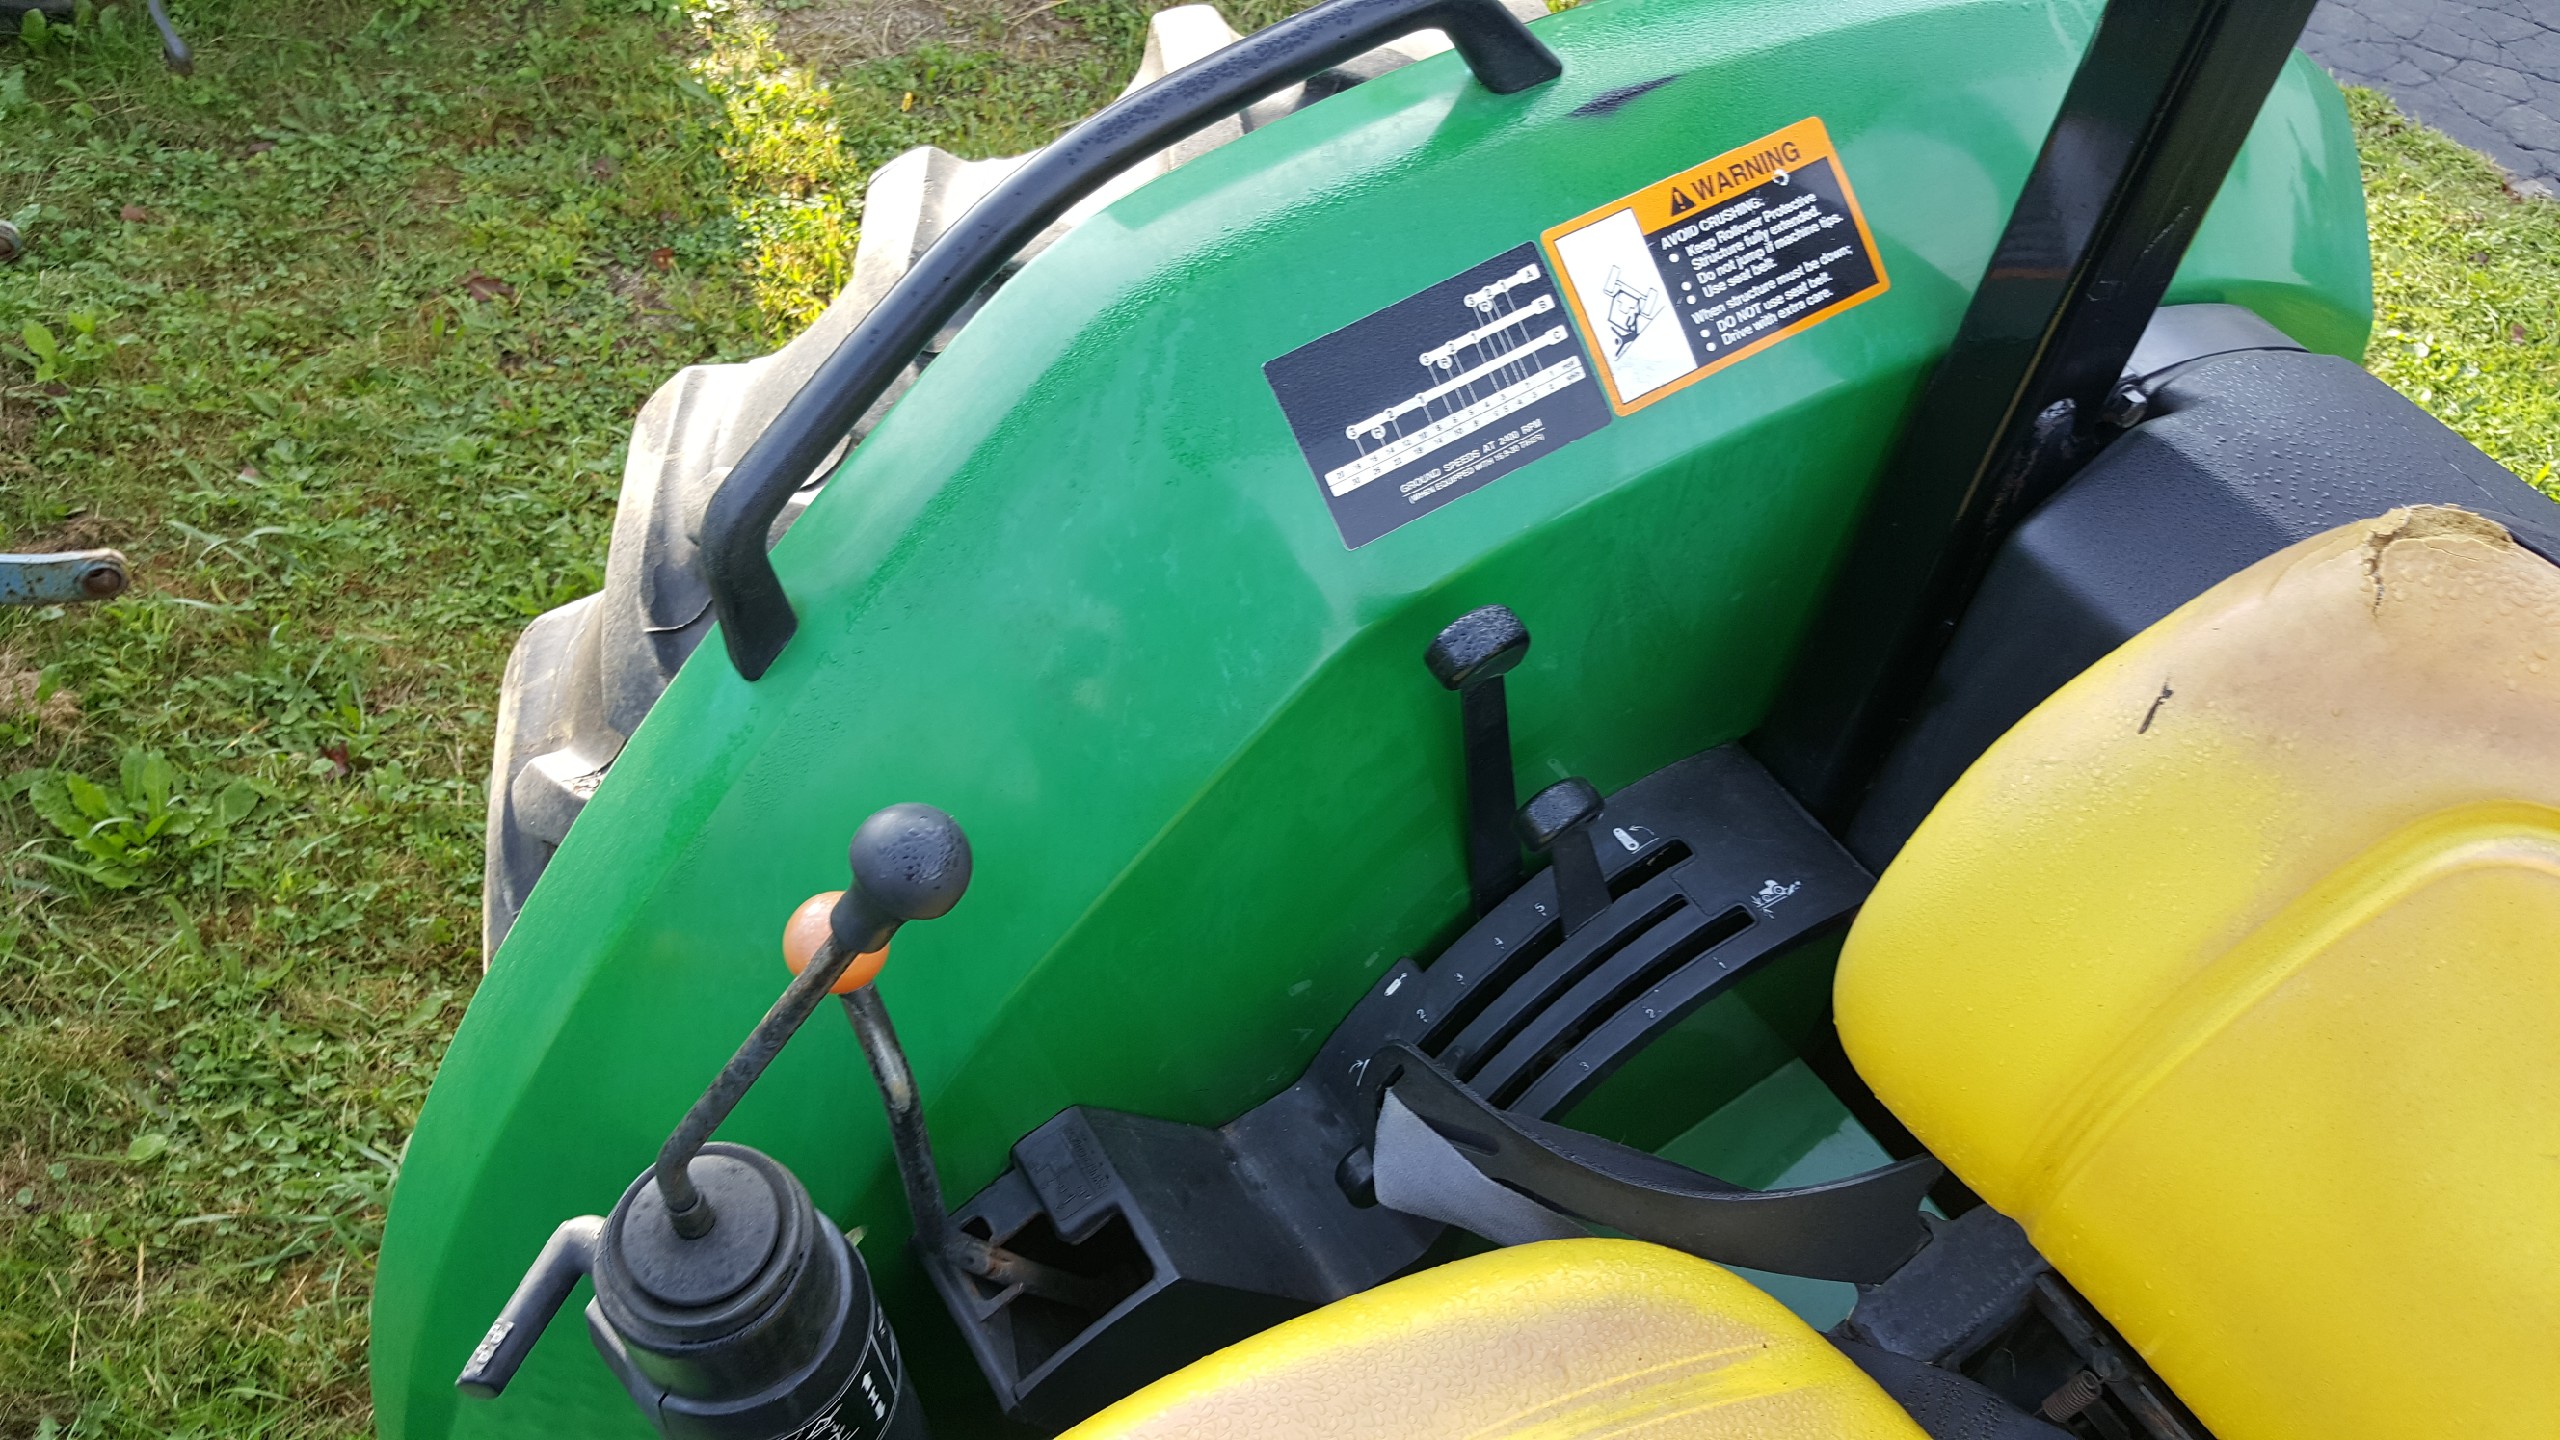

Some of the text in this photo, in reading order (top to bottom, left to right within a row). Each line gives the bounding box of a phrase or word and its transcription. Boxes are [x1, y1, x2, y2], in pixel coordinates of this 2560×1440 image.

[1689, 141, 1801, 200] WARNING
[1661, 224, 1699, 250] AVOID
[1684, 193, 1817, 256] Keep Rollover Protective
[1691, 205, 1822, 270] Structure fully extended.
[1695, 213, 1843, 283] Do not jump if machine tips.
[1526, 270, 1533, 278] A
[1690, 304, 1726, 324] When
[1725, 279, 1776, 308] structure
[1775, 264, 1805, 285] must
[1802, 259, 1820, 272] be
[1701, 257, 1777, 297] Use seat belt.
[1538, 300, 1547, 308] B
[1715, 315, 1736, 332] DO
[1735, 302, 1761, 322] NOT
[1762, 294, 1785, 309] use
[1784, 281, 1809, 300] seat
[1720, 288, 1833, 345] Drive with extra care.
[1553, 330, 1560, 339] C
[1399, 468, 1441, 492] GROUND
[1442, 449, 1480, 471] SPEEDS
[1482, 440, 1495, 453] AT
[1520, 418, 1542, 434] RPM
